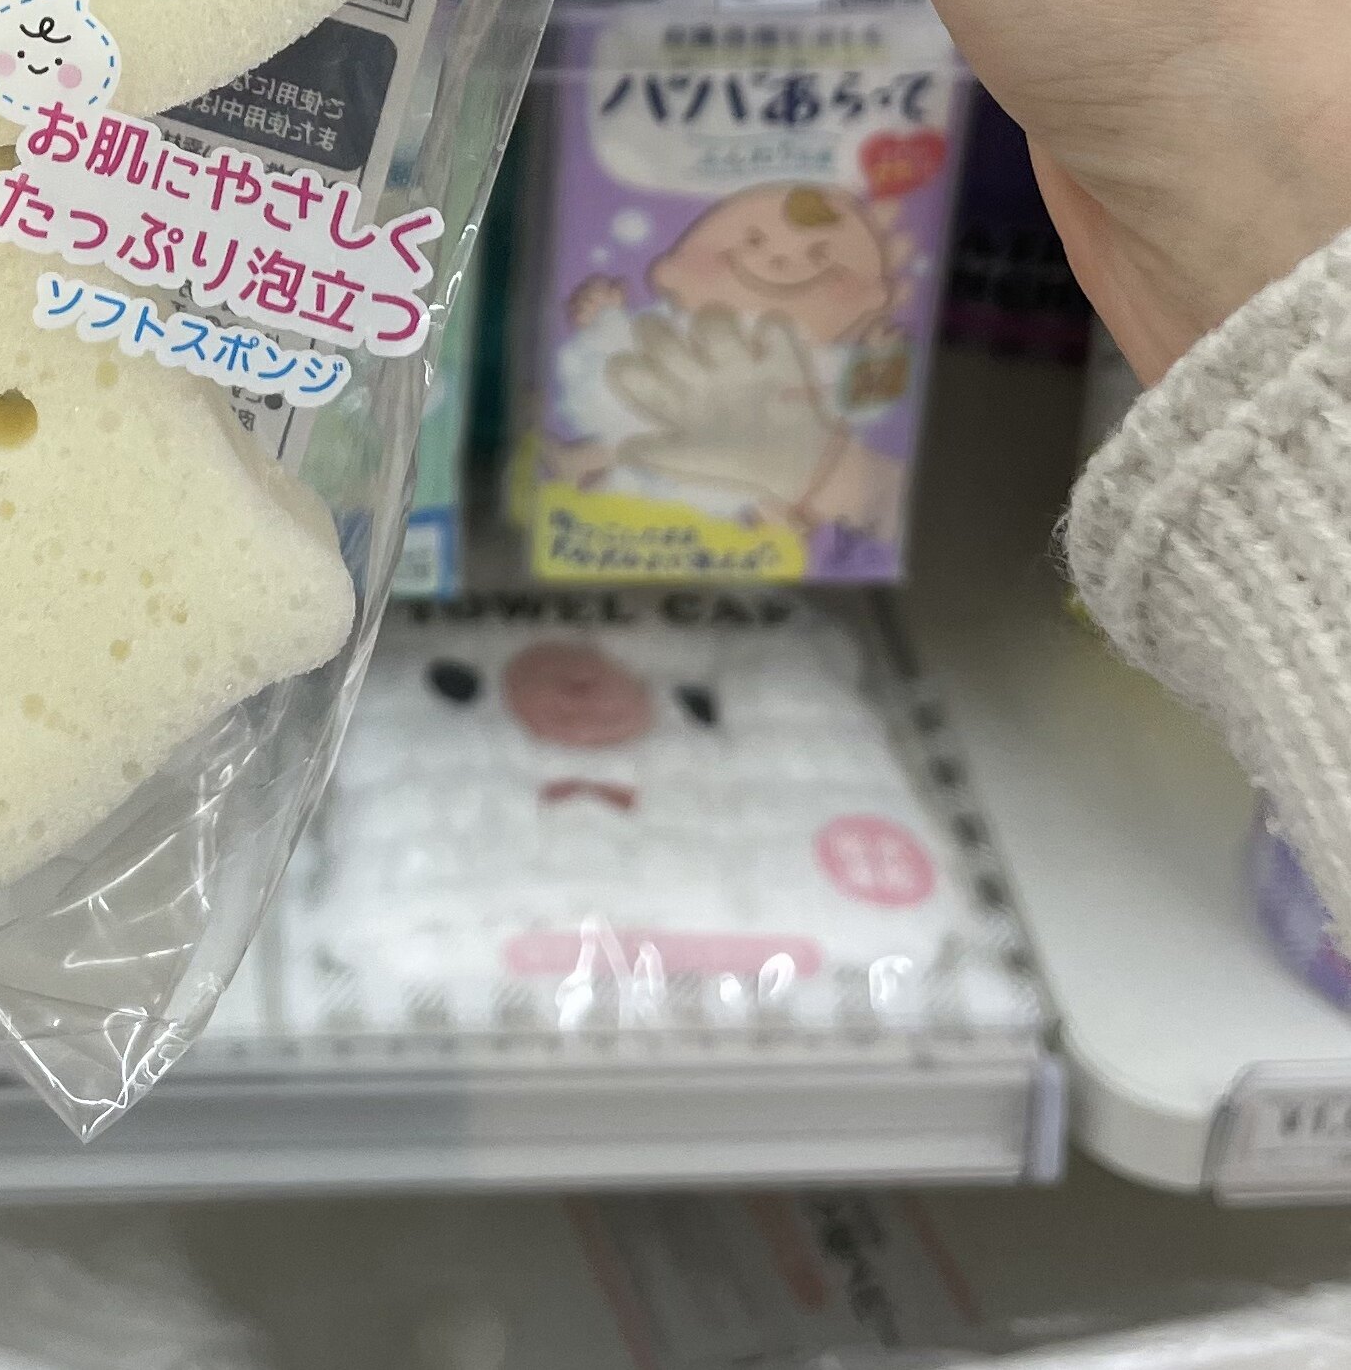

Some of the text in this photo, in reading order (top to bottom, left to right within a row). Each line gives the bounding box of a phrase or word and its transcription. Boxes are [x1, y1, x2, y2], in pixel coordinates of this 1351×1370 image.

[27, 101, 432, 273] お肌にやさしく
[49, 279, 344, 394] ソフトスポンジ
